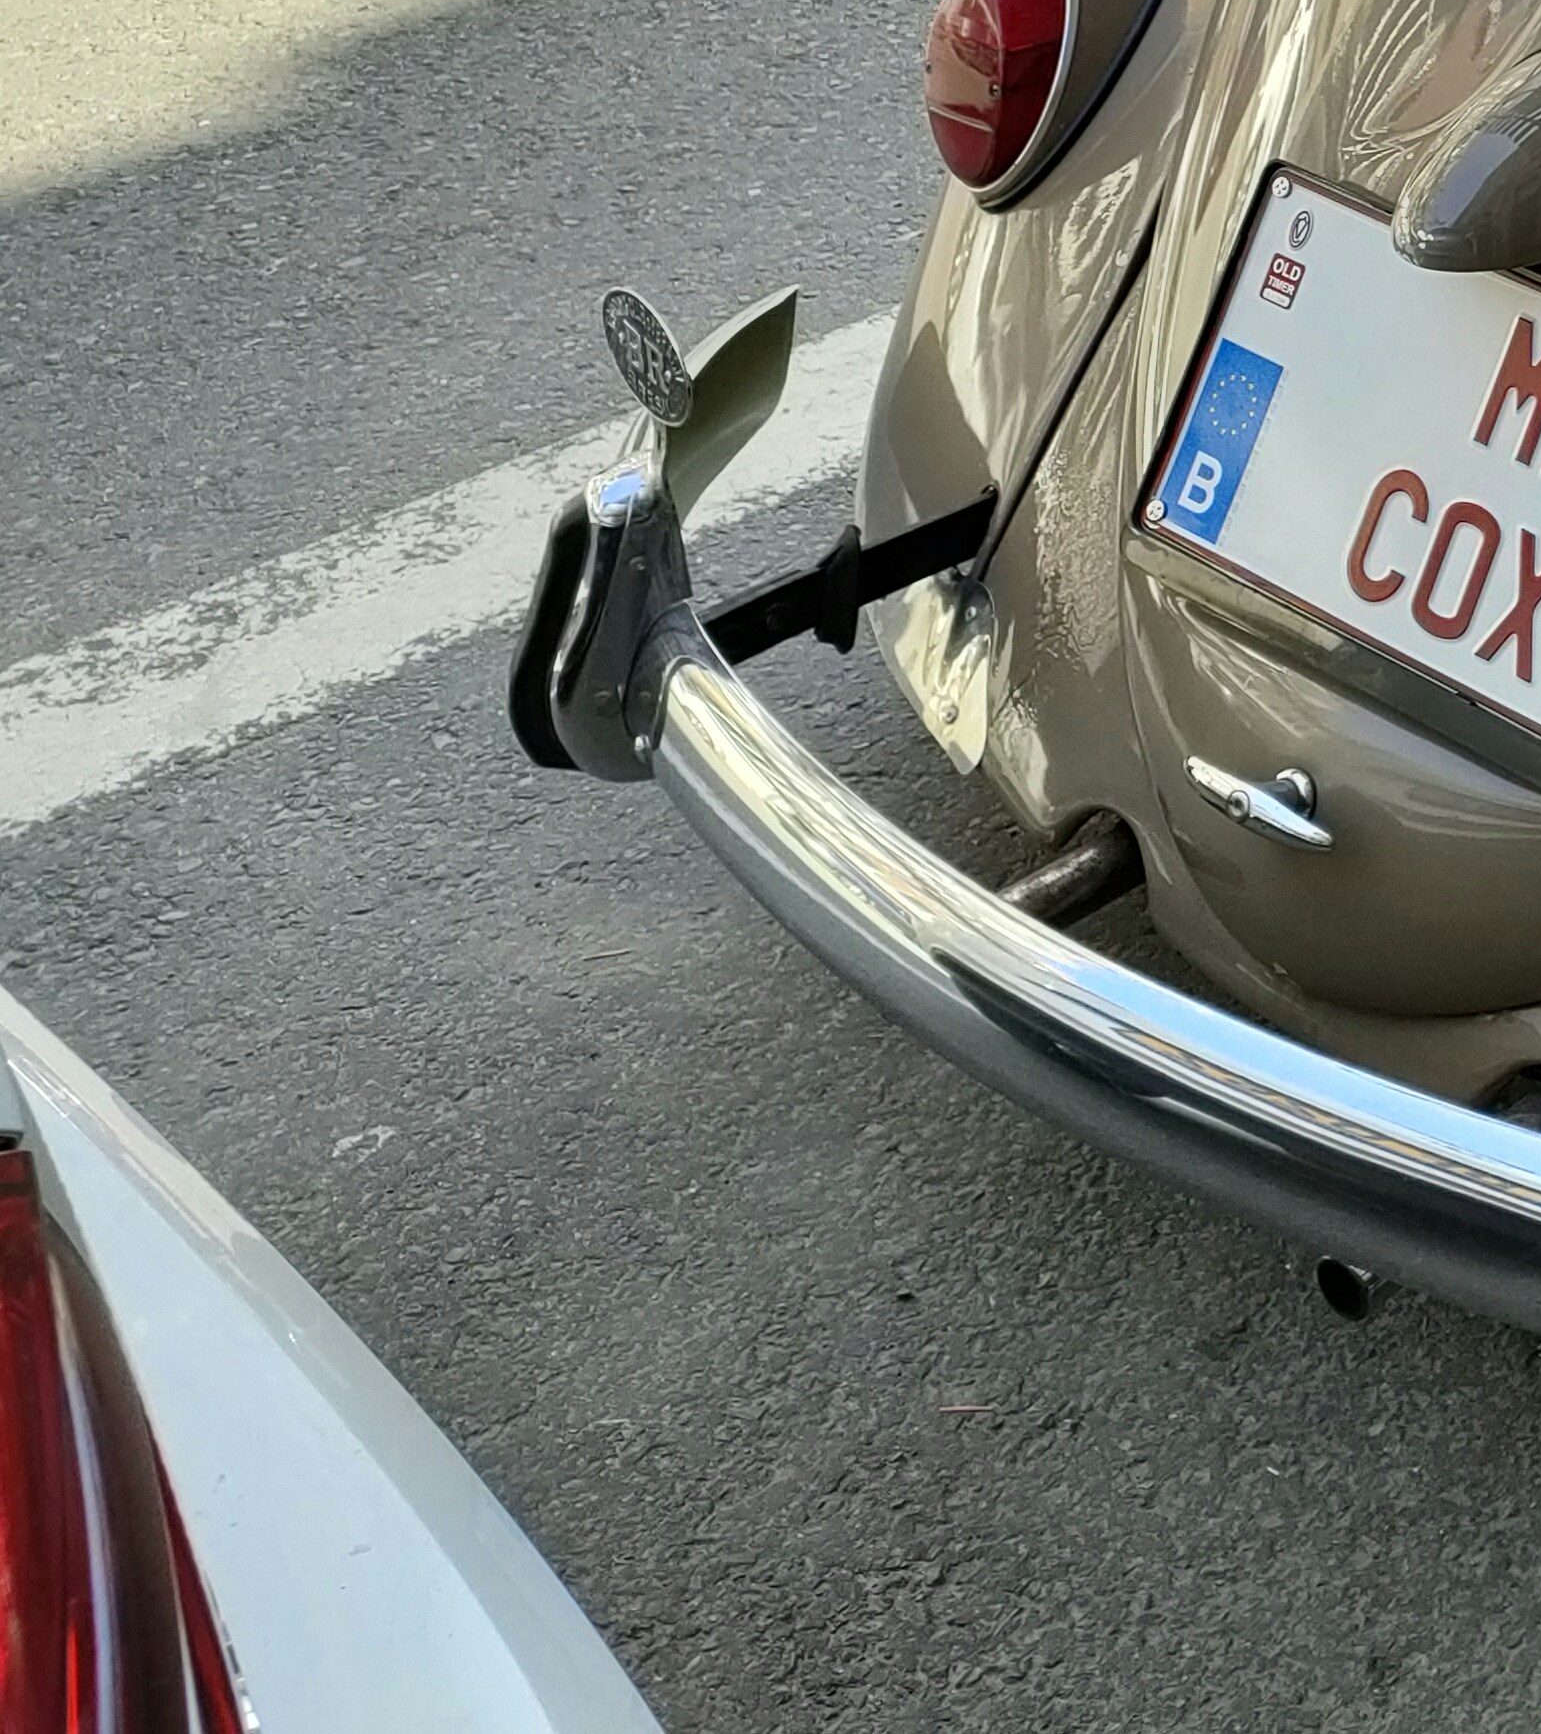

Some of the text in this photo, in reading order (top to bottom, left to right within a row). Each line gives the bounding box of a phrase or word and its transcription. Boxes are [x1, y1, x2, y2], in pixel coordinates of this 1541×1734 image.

[1272, 258, 1301, 282] OLD
[1268, 275, 1295, 296] TIMER
[1178, 451, 1222, 513] B
